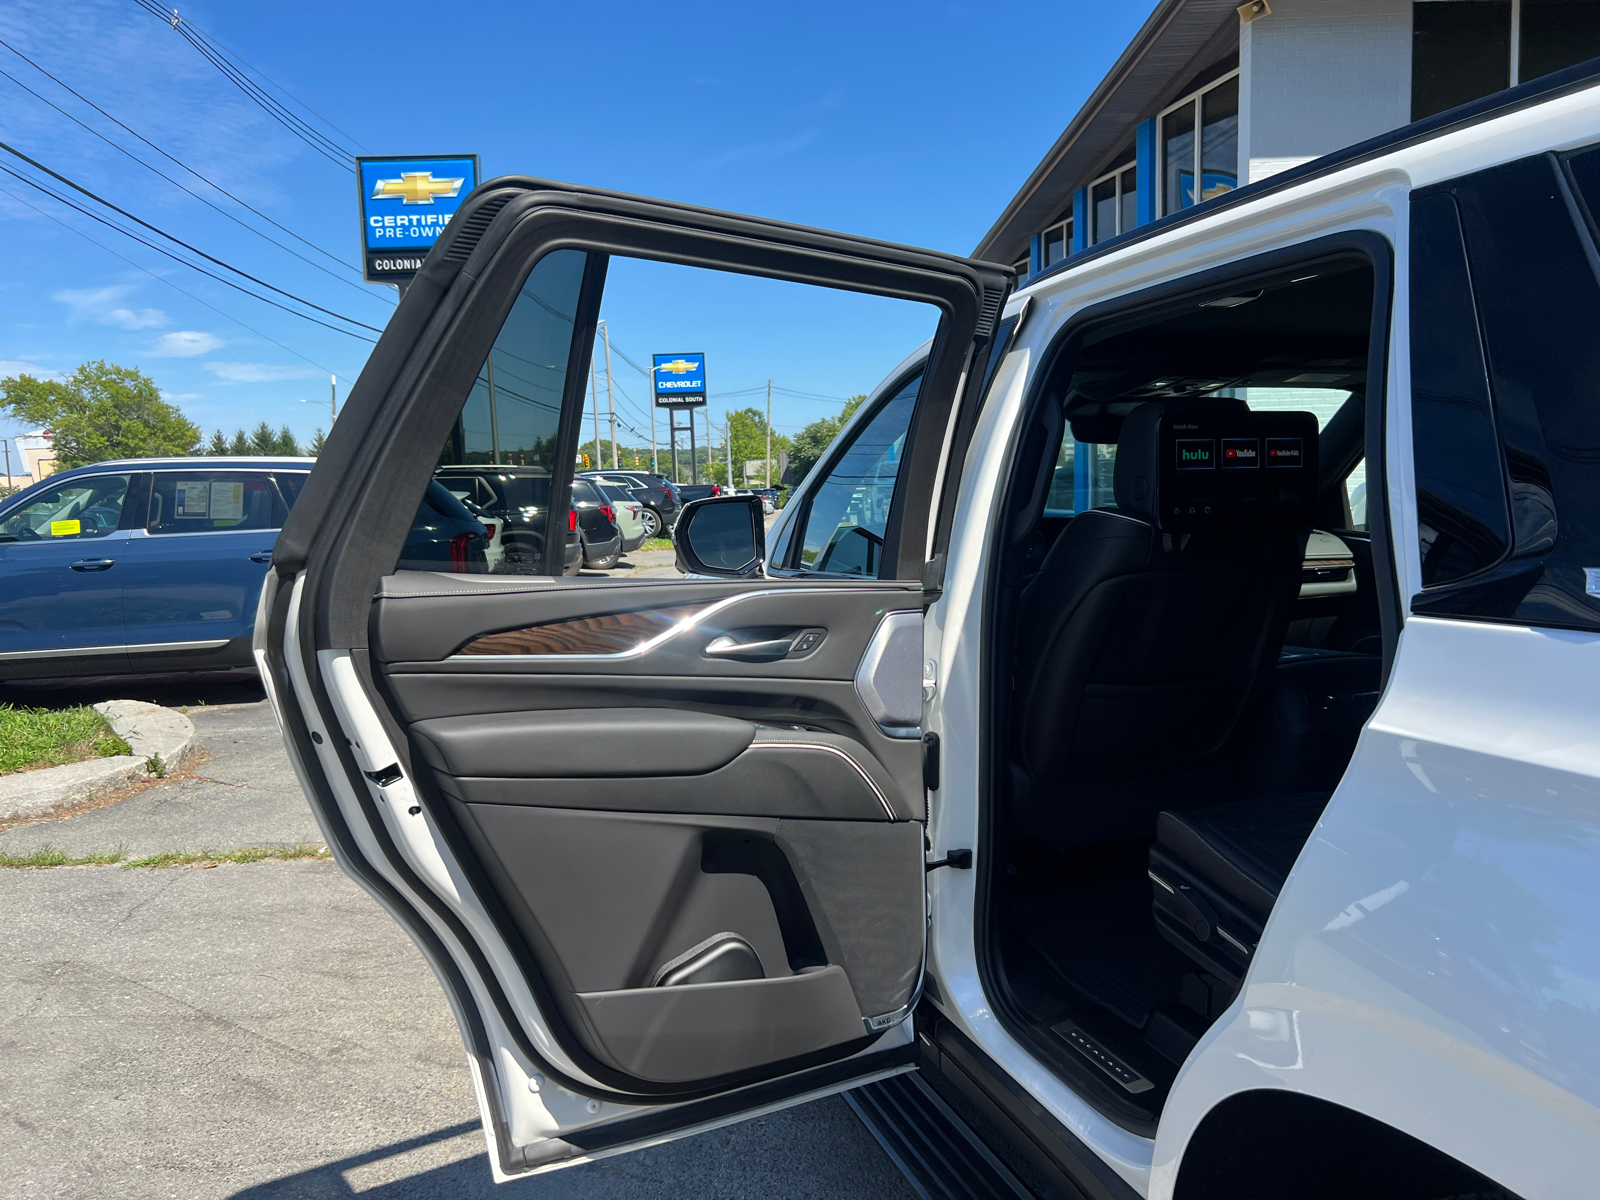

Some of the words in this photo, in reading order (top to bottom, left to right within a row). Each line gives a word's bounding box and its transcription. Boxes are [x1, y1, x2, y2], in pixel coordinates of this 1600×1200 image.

[375, 258, 425, 270] COLONIA
[658, 380, 702, 388] CHEVROLET
[1182, 449, 1209, 460] hulu
[1236, 449, 1256, 457] YouTube
[877, 1017, 891, 1026] AKG
